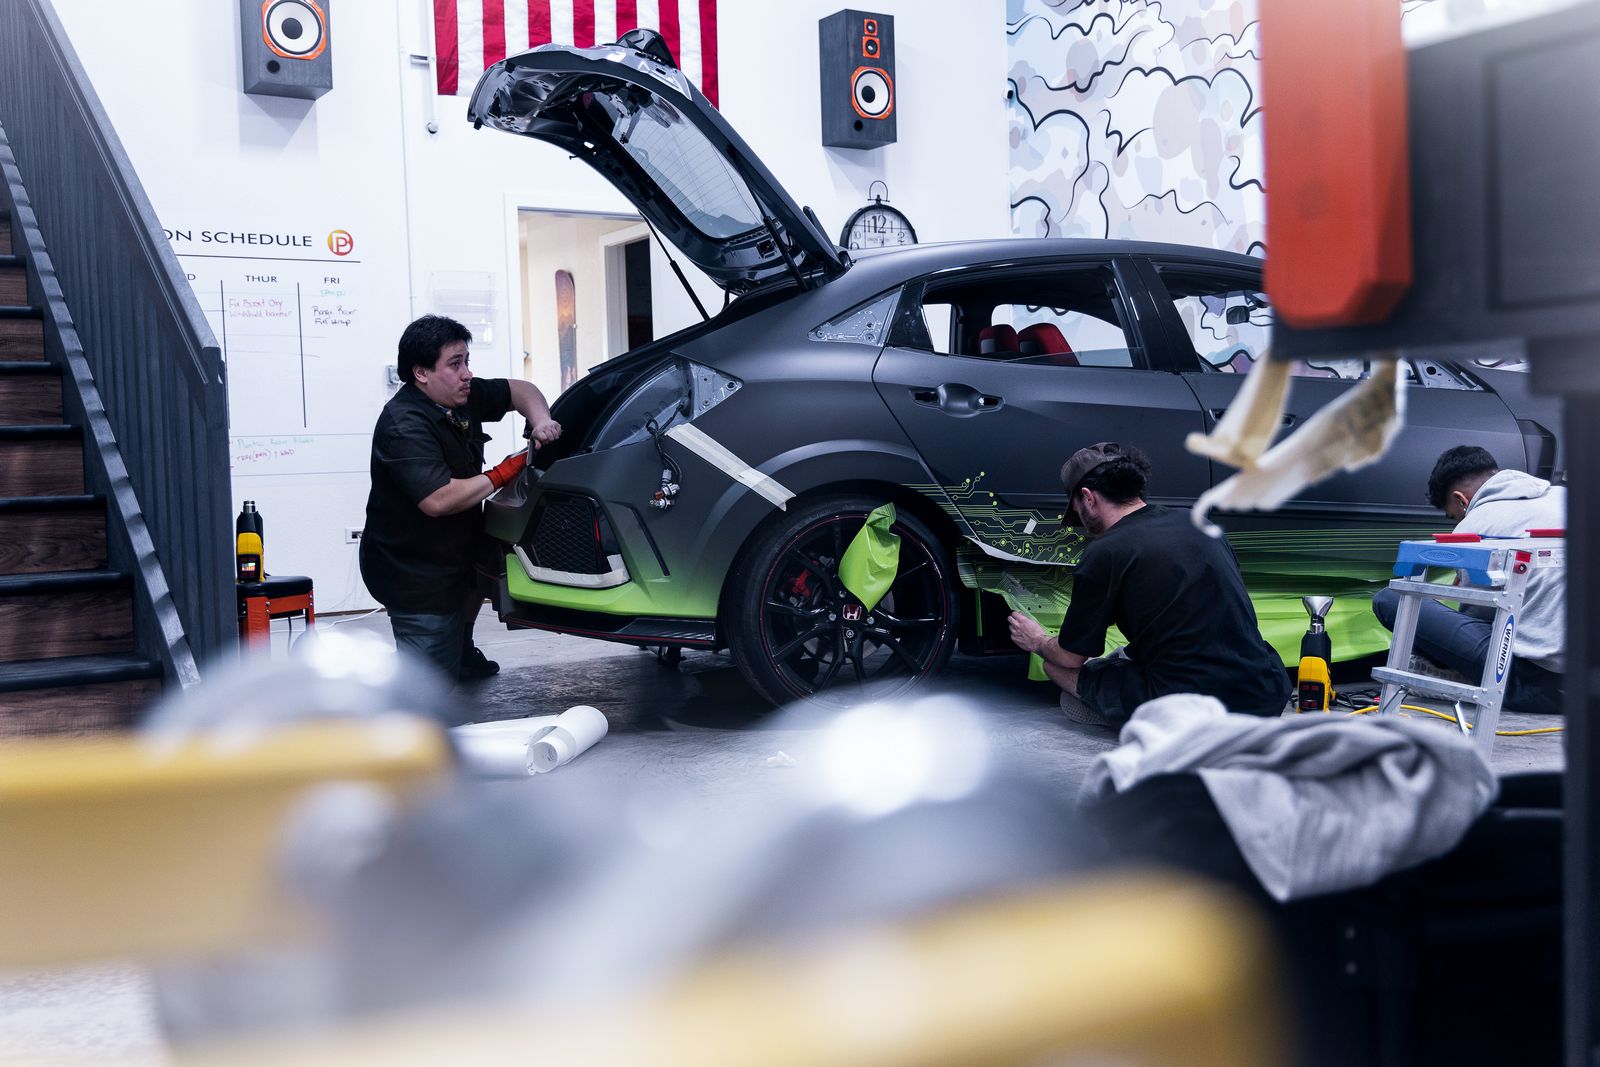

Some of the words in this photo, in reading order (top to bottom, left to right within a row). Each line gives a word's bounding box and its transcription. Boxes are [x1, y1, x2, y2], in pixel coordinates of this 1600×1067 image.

[872, 215, 886, 233] 12
[201, 231, 312, 247] SCHEDULE
[245, 275, 277, 283] THUR
[1498, 628, 1512, 671] WERNER
